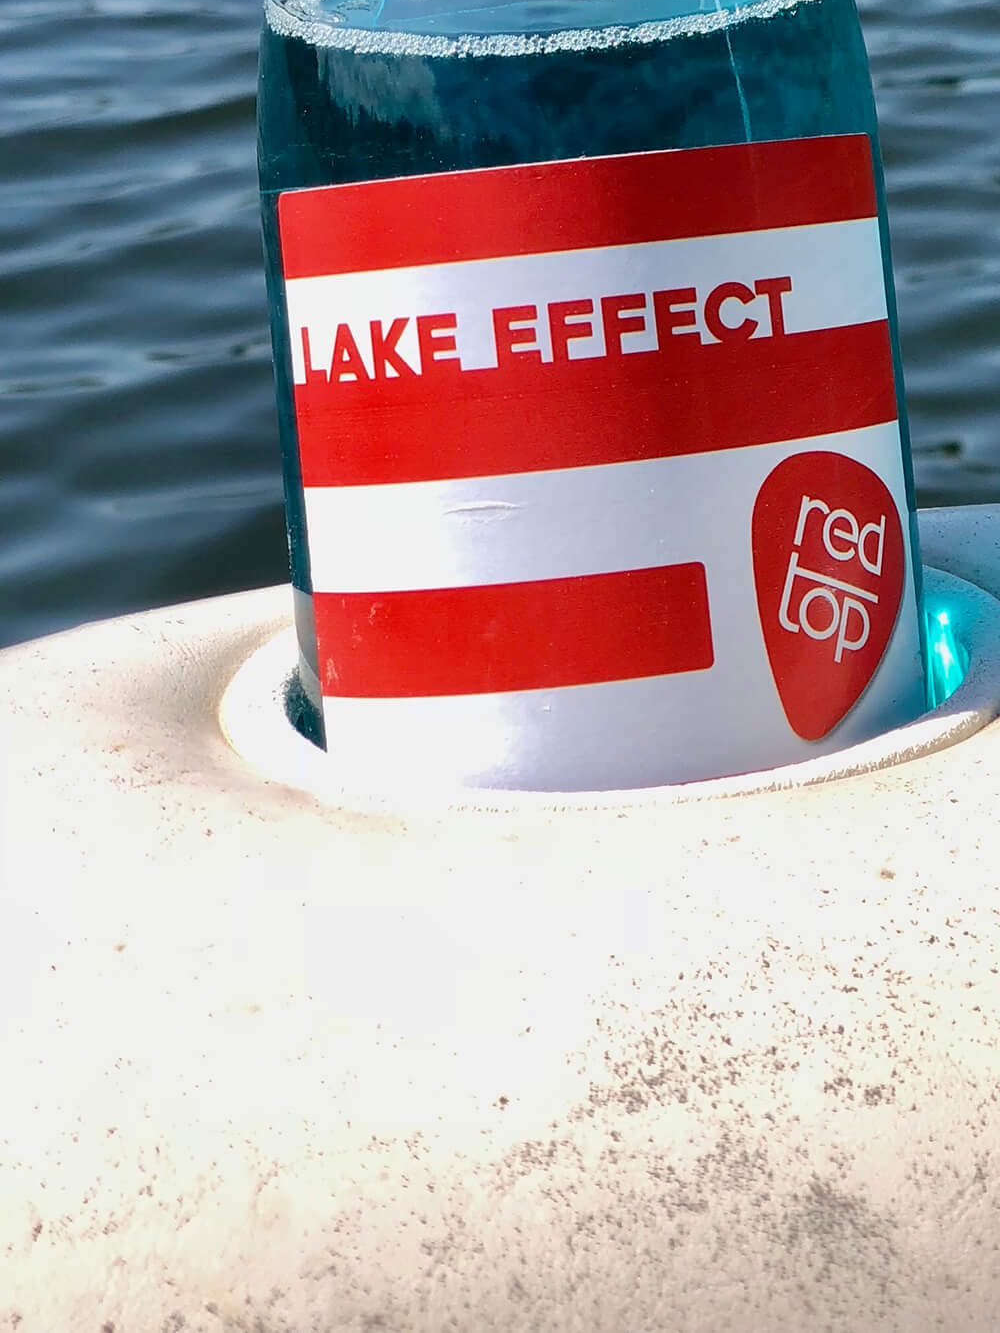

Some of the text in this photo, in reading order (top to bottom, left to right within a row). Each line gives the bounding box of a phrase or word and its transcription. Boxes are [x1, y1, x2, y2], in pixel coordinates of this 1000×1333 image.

[300, 275, 793, 384] LAKE EFFECT
[792, 494, 888, 576] red
[778, 551, 879, 663] top
